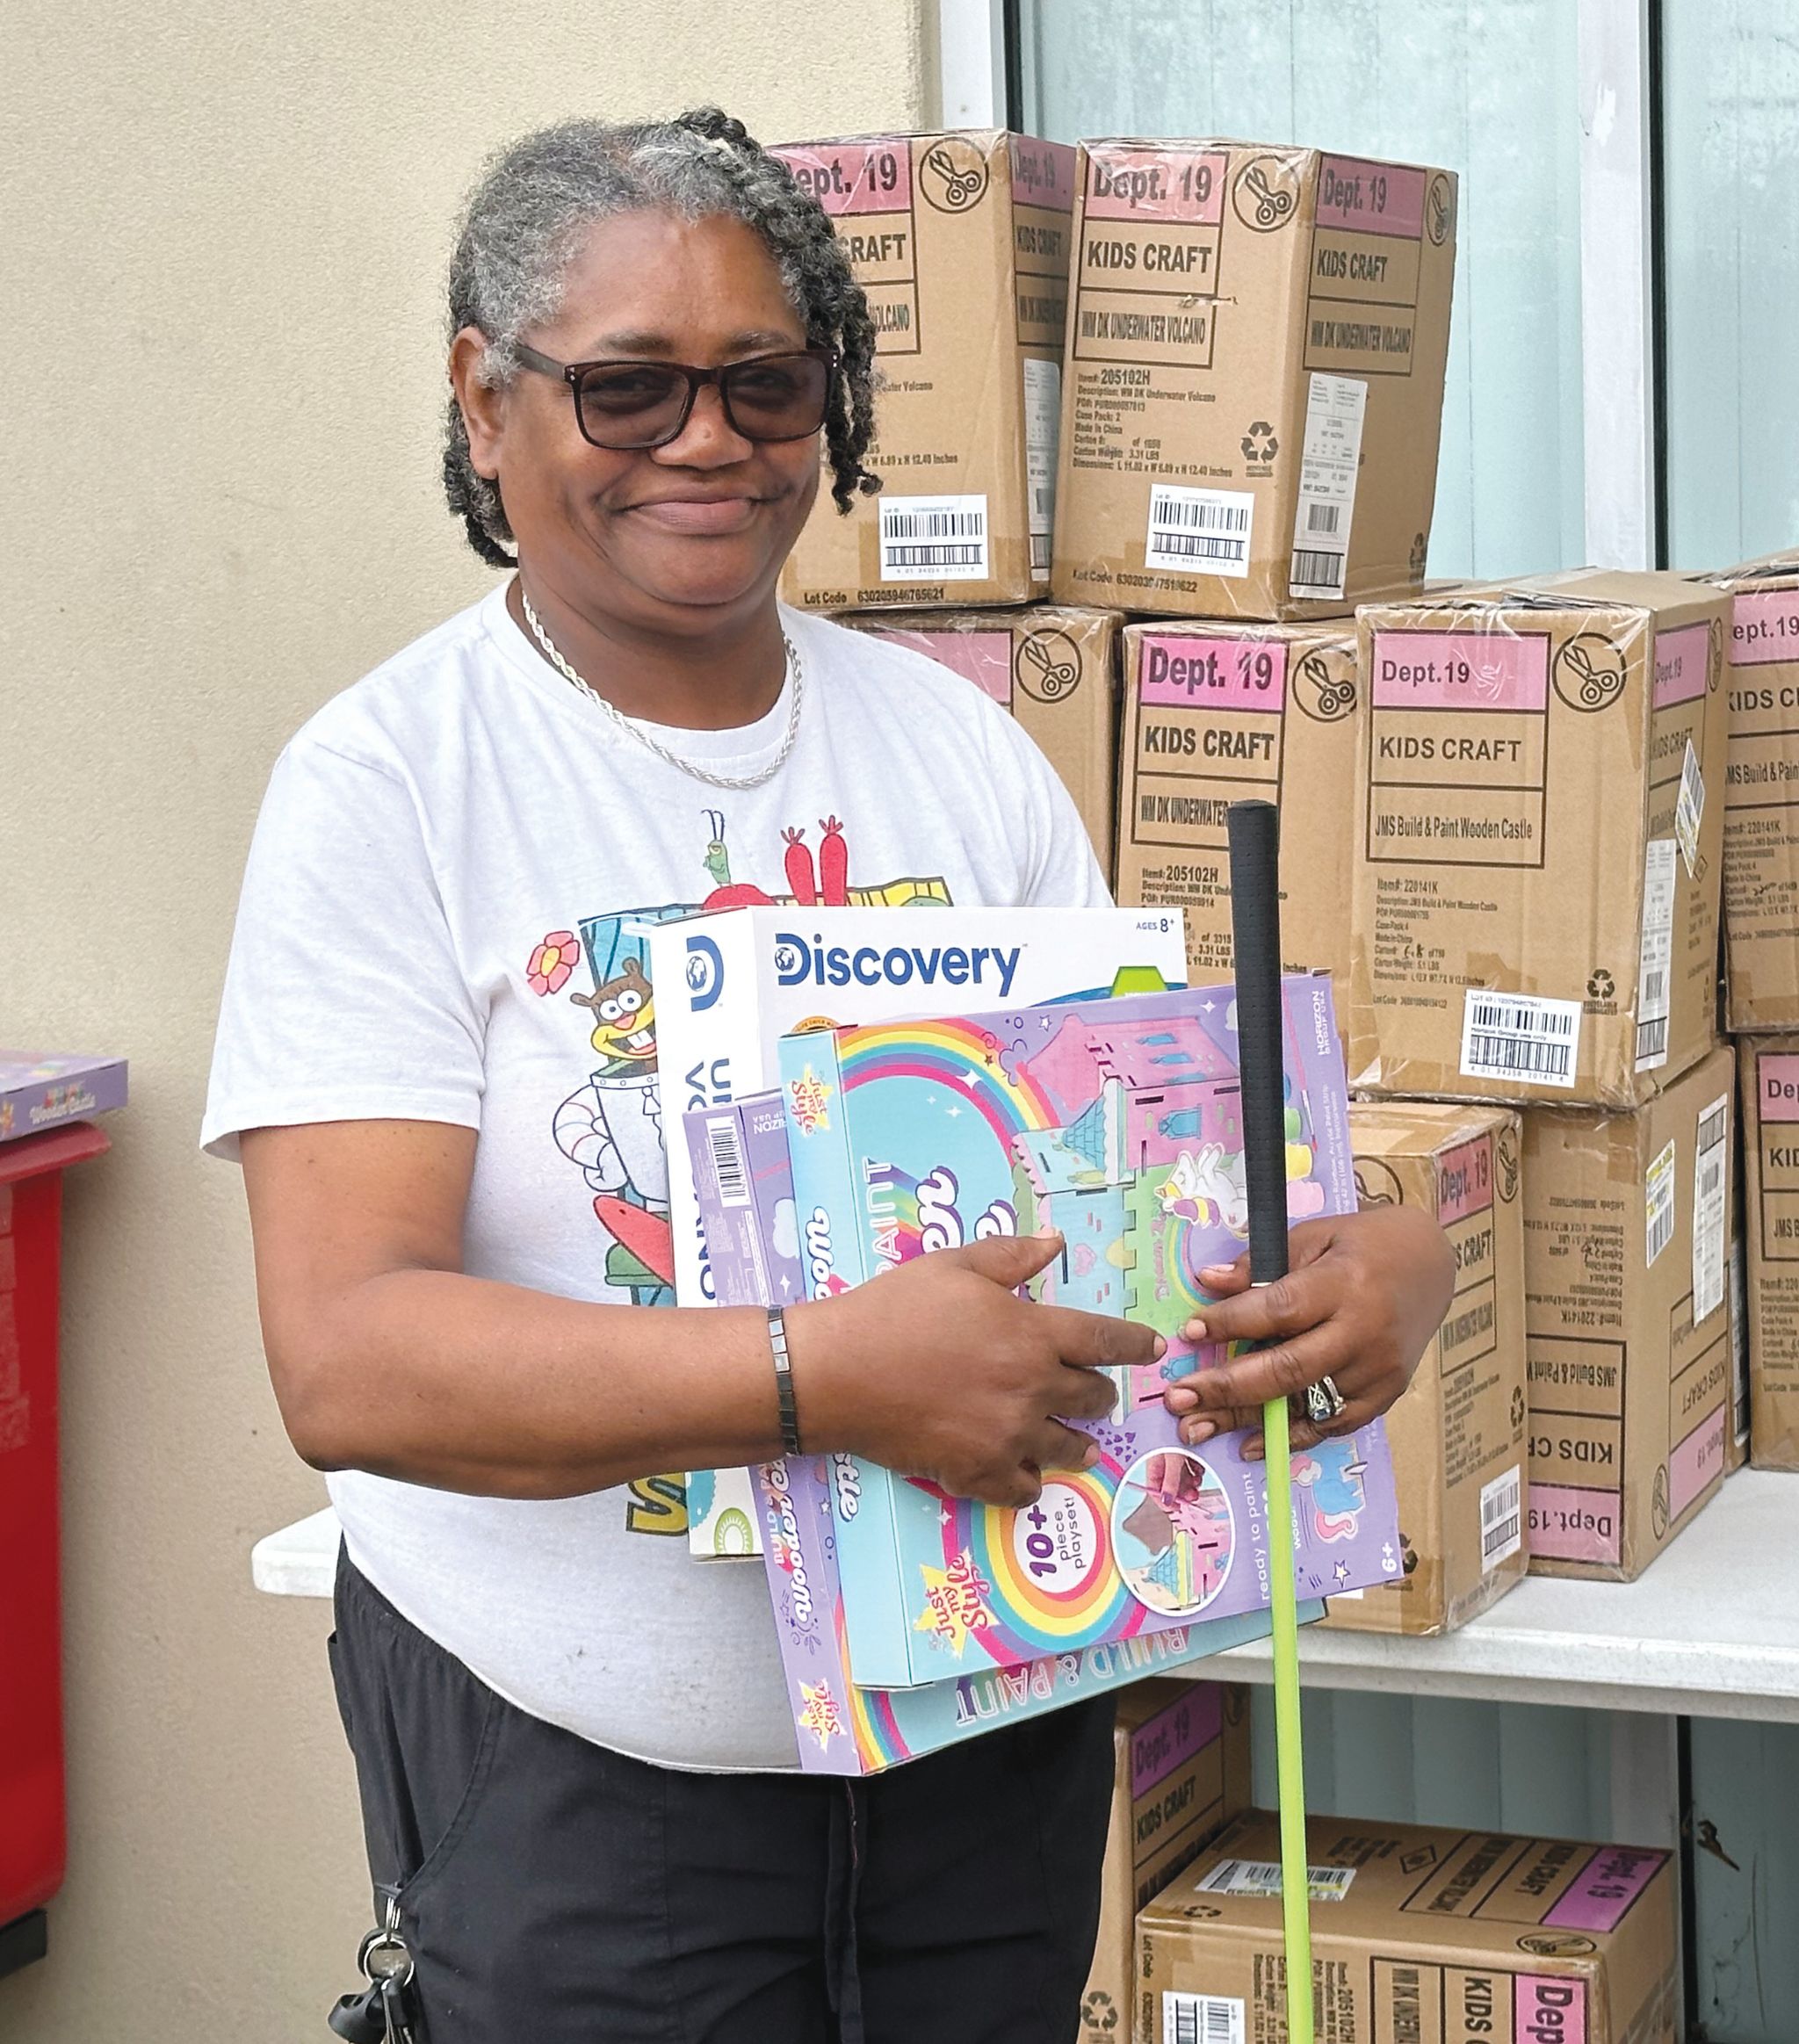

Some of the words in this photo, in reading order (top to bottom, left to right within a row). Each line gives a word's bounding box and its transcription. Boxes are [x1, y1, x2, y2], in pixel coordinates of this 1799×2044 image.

[788, 158, 852, 196] ept.
[868, 152, 898, 191] 19
[1093, 161, 1167, 209] Dept.
[1180, 164, 1212, 203] 19
[1324, 169, 1362, 218] Dept.
[1370, 176, 1387, 214] 19
[846, 234, 907, 264] RAFT
[1017, 224, 1036, 254] KIDS
[1087, 240, 1137, 270] KIDS
[1143, 242, 1212, 274] CRAFT
[1318, 249, 1347, 279] KIDS
[1350, 252, 1388, 283] CRAFT
[1097, 312, 1109, 338] DK
[1110, 312, 1166, 342] UNDERWATER
[1167, 316, 1206, 344] VOLCANO
[1101, 368, 1151, 386] 205102H
[1146, 389, 1187, 401] Underwater
[1188, 391, 1217, 403] Volcano
[1103, 423, 1123, 435] China
[804, 591, 820, 604] Lot
[822, 590, 848, 604] Code
[1732, 616, 1799, 644] ept.19
[1148, 646, 1225, 696] Dept.
[1238, 651, 1273, 690] 19
[1145, 725, 1196, 756] KIDS
[1203, 729, 1275, 761] CRAFT
[1379, 736, 1434, 760] KIDS
[1441, 738, 1521, 762] CRAFT
[1744, 763, 1768, 784] Build
[1770, 762, 1777, 781] &
[1779, 761, 1799, 781] Pain
[1141, 794, 1157, 822] WM
[1157, 797, 1169, 823] DK
[1171, 797, 1228, 827] UNDERWATER
[1375, 814, 1396, 837] JMS
[1397, 815, 1423, 838] Build
[1425, 817, 1432, 837] &
[1434, 817, 1459, 838] Paint
[1460, 818, 1500, 839] Wooden
[1501, 819, 1533, 841] Castle
[1142, 881, 1186, 894] Description:
[1202, 885, 1213, 895] DK
[1143, 868, 1165, 879] Item#:
[1166, 865, 1218, 884] 205102H
[1198, 945, 1214, 956] 3.31
[1216, 945, 1231, 956] LBS
[1201, 932, 1210, 942] of
[775, 933, 1021, 997] Discovery
[1311, 990, 1327, 1056] HORIZON
[791, 1080, 815, 1135] Style
[808, 1077, 829, 1116] Just
[754, 1118, 787, 1135] IZON
[1769, 1147, 1799, 1168] KID
[1440, 1164, 1471, 1210] Dept.
[1475, 1148, 1488, 1188] 19
[1774, 1218, 1793, 1239] JMS
[1463, 1229, 1492, 1269] CRAFT
[1535, 1362, 1560, 1384] Paint
[1561, 1363, 1568, 1385] &
[1570, 1365, 1595, 1386] Build
[1597, 1366, 1618, 1388] JMS
[1682, 1376, 1708, 1415] CRAFT
[1558, 1439, 1613, 1464] KIDS
[1241, 1471, 1261, 1519] paint
[766, 1510, 785, 1564] BUILD
[1026, 1504, 1058, 1578] 10+
[1056, 1510, 1072, 1562] piece
[1066, 1496, 1087, 1570] playset!
[1250, 1523, 1262, 1542] to
[778, 1494, 813, 1623] Wooden
[1380, 1542, 1398, 1573] 6+
[1254, 1548, 1271, 1602] ready
[943, 1586, 961, 1614] my
[946, 1555, 992, 1630] Style
[924, 1585, 957, 1639] Just
[1056, 1654, 1080, 1686] &
[1088, 1628, 1188, 1679] BUILD
[813, 1679, 841, 1736] Style
[955, 1663, 1052, 1728] PAINT
[803, 1698, 823, 1736] Just
[1135, 1723, 1170, 1777] Dept.
[1174, 1705, 1191, 1742] 19
[1136, 1800, 1162, 1845] KIDS
[1163, 1774, 1196, 1824] CRAFT
[1586, 1884, 1628, 1899] 19
[1143, 1934, 1153, 1950] Lot
[1143, 1953, 1153, 1979] Code
[1338, 1988, 1355, 2044] 205102H
[1464, 1976, 1492, 2033] KIDS
[1527, 1984, 1573, 2044] Dep
